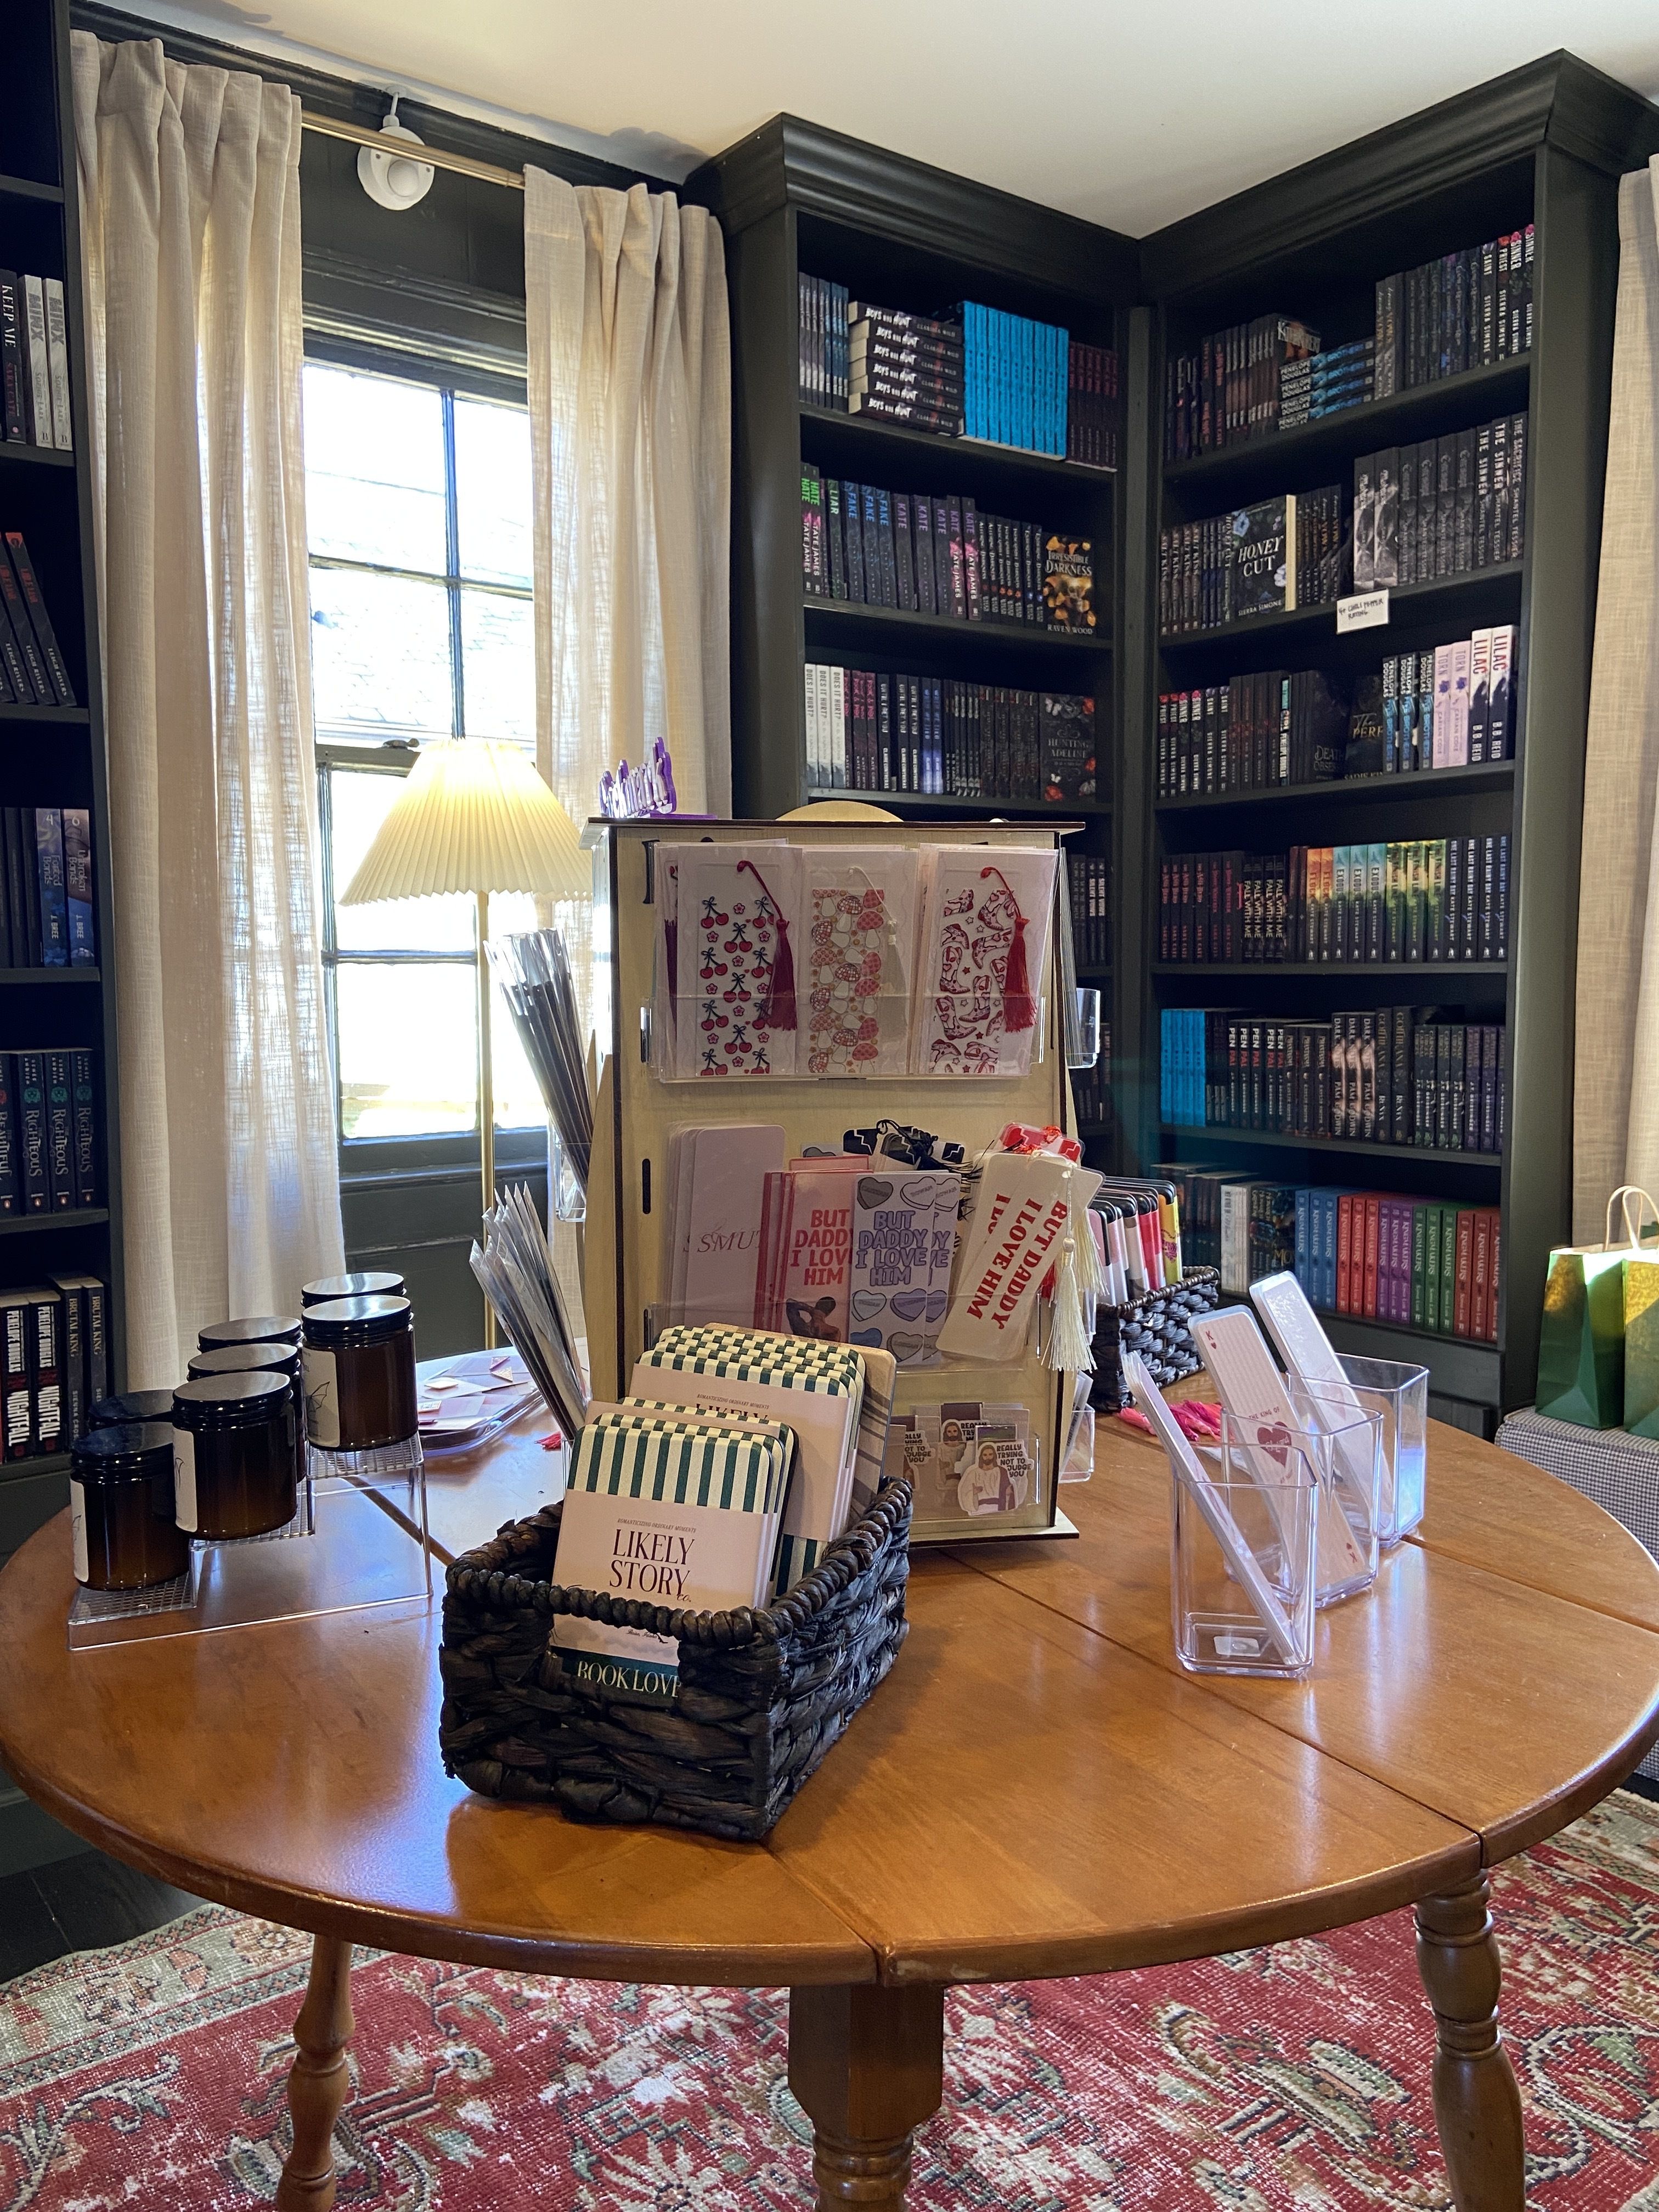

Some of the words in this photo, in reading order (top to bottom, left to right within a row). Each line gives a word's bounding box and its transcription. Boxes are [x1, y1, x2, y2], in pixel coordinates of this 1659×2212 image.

[1484, 255, 1492, 276] SAINT
[1499, 248, 1508, 272] PRIEST
[3, 285, 14, 321] KEEP
[29, 293, 44, 342] MINX
[49, 297, 64, 345] MINX
[4, 328, 15, 347] ME
[868, 398, 884, 410] BOYS
[1495, 423, 1505, 445] THE
[1514, 419, 1523, 436] THE
[1479, 430, 1489, 452] THE
[1494, 452, 1505, 490] SINNER
[1512, 438, 1523, 483] SACRIFICE
[1478, 458, 1488, 496] SINNER
[801, 478, 810, 503] HATE
[810, 481, 820, 506] HATE
[830, 490, 839, 515] LIAR
[849, 493, 857, 519] FAKE
[865, 495, 874, 522] FAKE
[879, 499, 889, 526] FAKE
[898, 503, 907, 529] KATE
[918, 505, 928, 532] KATE
[937, 509, 946, 534] KATE
[950, 511, 960, 532] KATE
[966, 513, 975, 534] KATE
[952, 551, 961, 571] TATE
[1047, 551, 1089, 564] IRRESISTIBLE
[1238, 535, 1284, 563] HONEY
[968, 553, 977, 572] TATE
[1045, 560, 1092, 576] DARKNESS
[1243, 556, 1276, 577] CUT
[953, 571, 963, 598] JAMES
[969, 573, 978, 600] JAMES
[1238, 607, 1257, 617] SIERRA
[1258, 600, 1282, 612] SIMONE
[1348, 610, 1368, 620] RATING
[1047, 624, 1070, 633] RAVEN
[1072, 627, 1093, 635] WOOD
[1437, 653, 1448, 675] TORN
[1455, 651, 1466, 672] TORN
[1473, 639, 1488, 675] LILAC
[1493, 635, 1508, 672] LILAC
[1048, 738, 1088, 748] HUNTING
[1051, 749, 1087, 759] ADELINE
[1471, 743, 1482, 761] REID
[1491, 741, 1502, 759] REID
[1245, 925, 1251, 938] ME
[1255, 925, 1261, 938] ME
[1266, 924, 1273, 938] ME
[25, 1110, 42, 1177] RIGHTEOUS
[52, 1109, 69, 1175] RIGHTEOUS
[78, 1108, 93, 1172] RIGHTEOUS
[1025, 1198, 1043, 1212] I
[811, 1209, 850, 1228] BUT
[873, 1210, 916, 1230] BUT
[1034, 1200, 1068, 1251] BUT
[795, 1228, 853, 1248] DADD
[859, 1228, 928, 1250] DADDY
[992, 1210, 1036, 1269] LOVE
[791, 1250, 802, 1267] I
[809, 1248, 853, 1267] LOV
[855, 1250, 867, 1268] I
[873, 1248, 928, 1267] LOVE
[1459, 1231, 1468, 1281] KINGMAKERS
[1476, 1233, 1486, 1283] KINGMAKERS
[804, 1267, 844, 1285] HIM
[870, 1266, 911, 1286] HIM
[967, 1269, 1003, 1319] HIM
[991, 1249, 1042, 1329] DADDY
[38, 1306, 50, 1338] PENELOPE
[69, 1298, 78, 1330] BRUTAL
[92, 1296, 101, 1329] BRUTAL
[7, 1311, 20, 1342] PENELOPE
[1205, 1331, 1216, 1341] K
[39, 1339, 52, 1368] DOUGLAS
[70, 1334, 79, 1357] KING
[93, 1331, 101, 1355] KING
[8, 1343, 21, 1372] DOUGLAS
[7, 1390, 30, 1447] NIGHTFALL
[37, 1385, 60, 1441] NIGHTFALL
[1260, 1409, 1272, 1418] KING
[617, 1518, 651, 1527] ROMANTICIZING
[613, 1529, 695, 1565] LIKELY
[610, 1560, 691, 1596] STORY
[577, 1660, 629, 1690] BOOK
